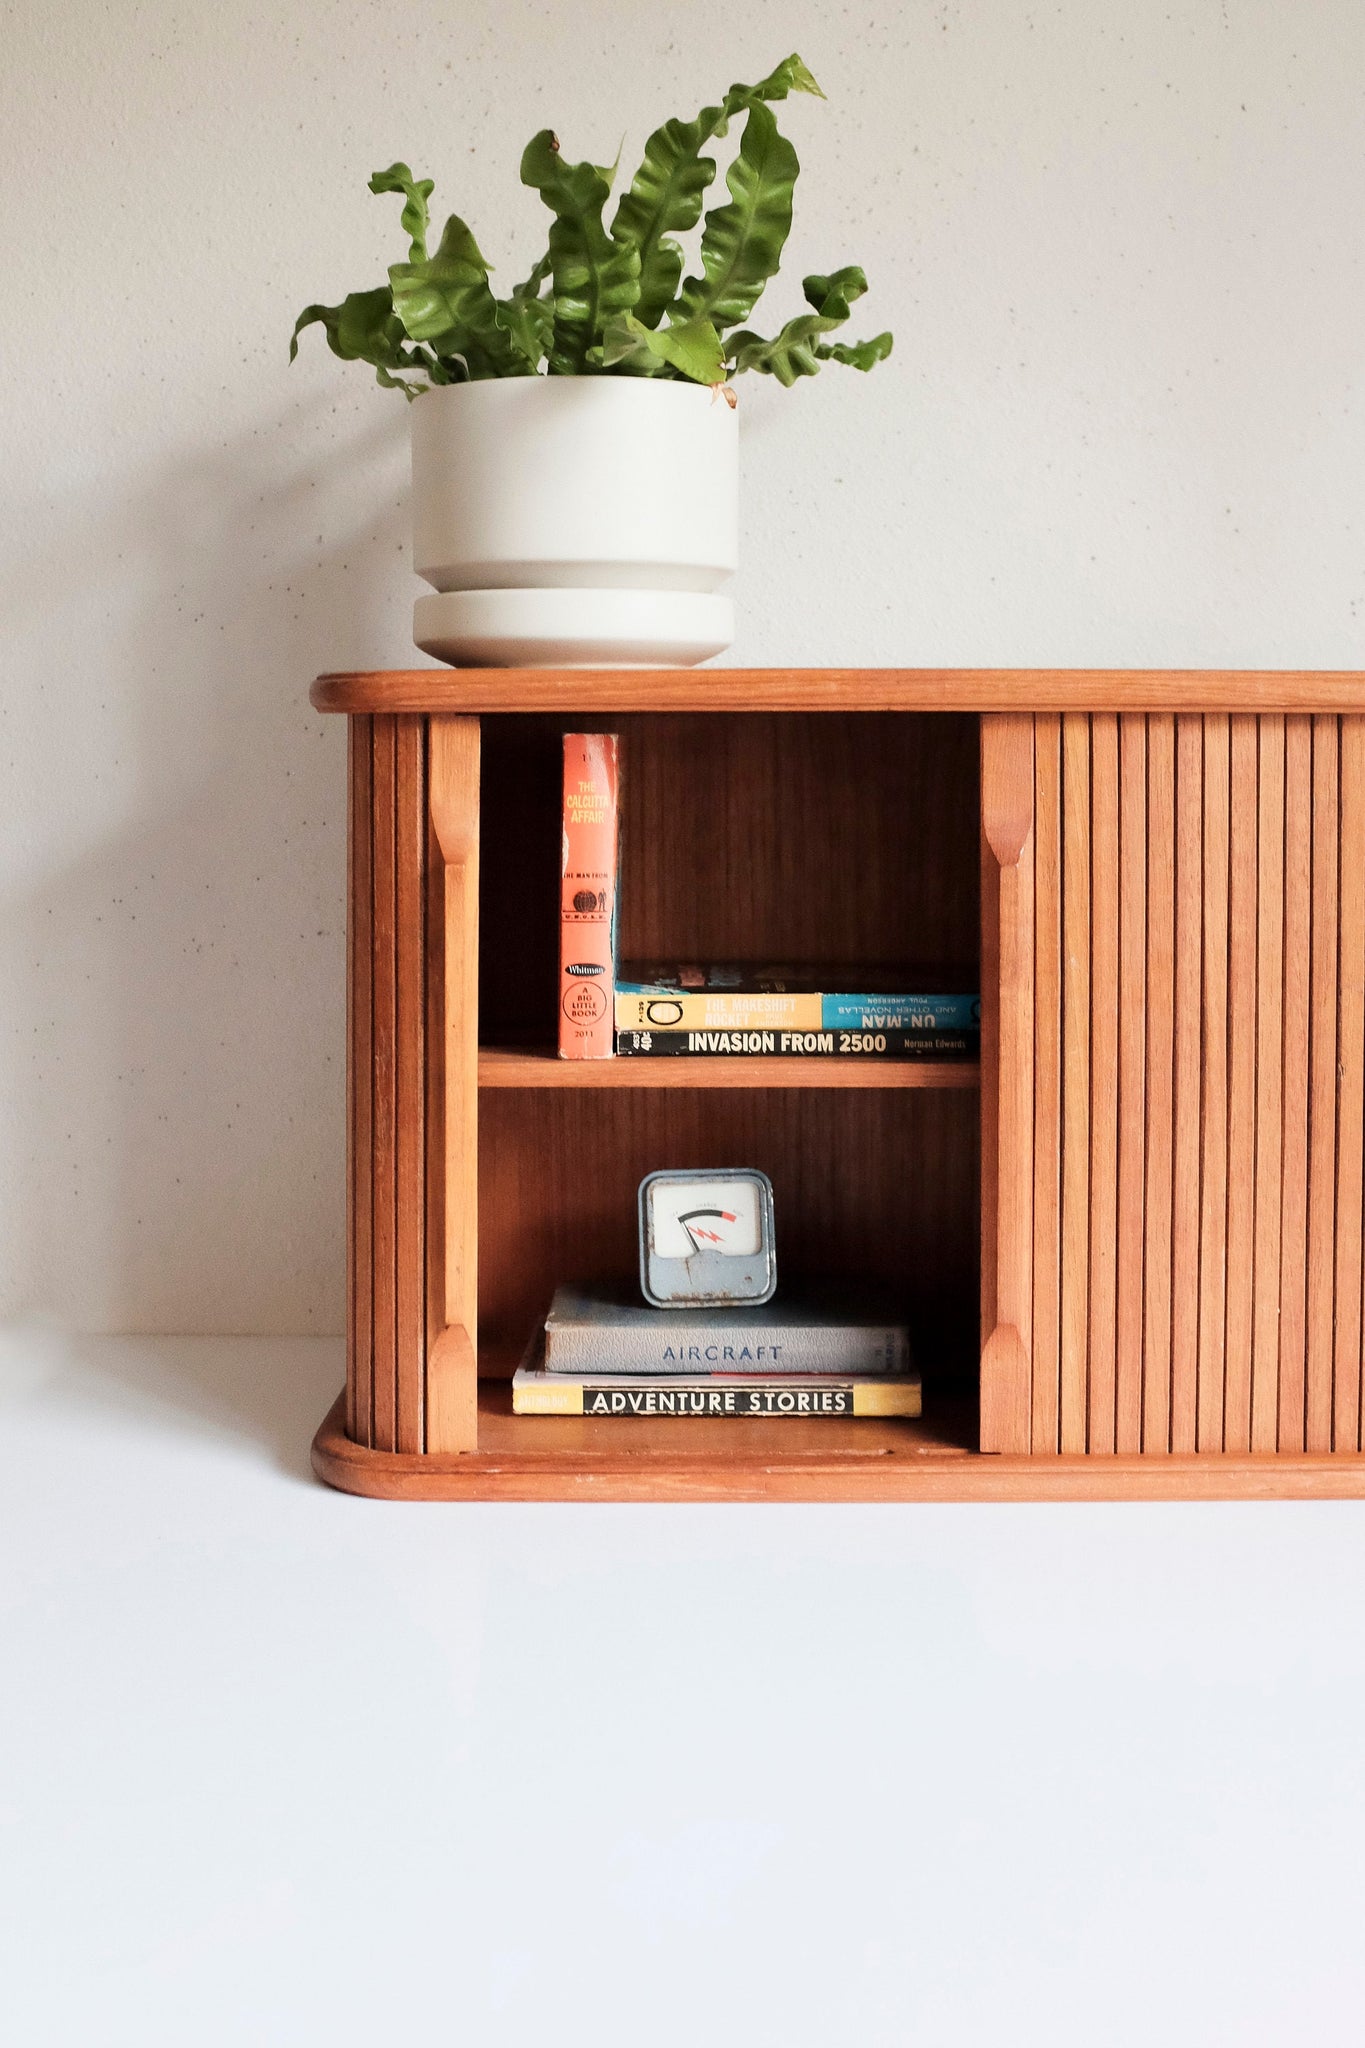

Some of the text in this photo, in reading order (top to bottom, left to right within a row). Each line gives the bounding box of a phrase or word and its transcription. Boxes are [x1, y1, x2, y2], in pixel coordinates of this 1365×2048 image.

[578, 781, 596, 792] THE
[566, 795, 610, 809] CALCUTTA
[570, 810, 605, 824] AFFAIR
[568, 965, 605, 975] Whitman
[582, 986, 588, 994] A
[577, 994, 592, 1002] BIG
[705, 998, 797, 1012] THE MAKESHIFT
[837, 1006, 957, 1014] AND OTHER NOVELLAS
[704, 1012, 750, 1027] ROCKET
[575, 1030, 594, 1038] 2011
[688, 1033, 887, 1052] INVASION FROM 2500
[904, 1038, 967, 1049] Norman Edwards
[662, 1345, 782, 1361] AIRCRAFT
[592, 1392, 736, 1411] ADVENTURE
[749, 1392, 846, 1411] STORIES
